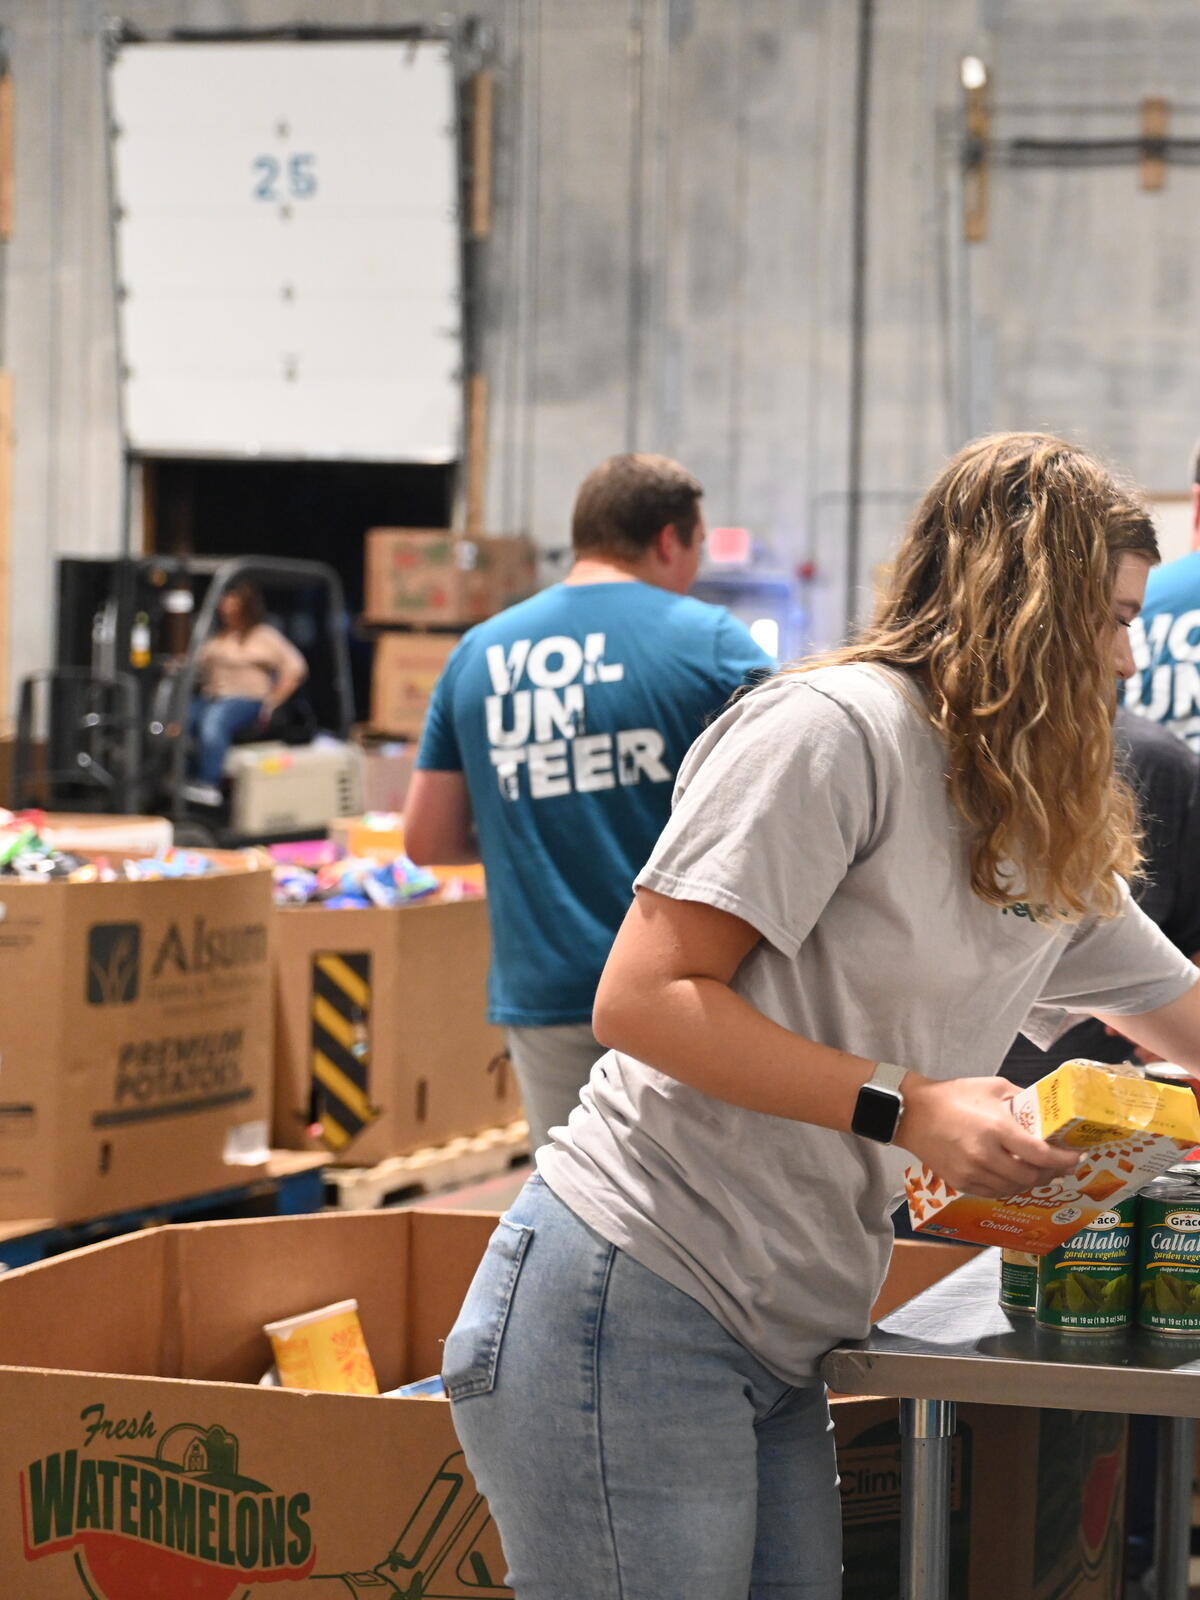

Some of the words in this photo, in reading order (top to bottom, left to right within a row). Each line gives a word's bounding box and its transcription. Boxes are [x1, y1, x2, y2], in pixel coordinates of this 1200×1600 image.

[252, 153, 318, 203] 25
[485, 632, 624, 696] VOL
[485, 685, 586, 748] UN
[489, 728, 674, 803] TEER
[980, 1219, 1023, 1234] Cheddar
[1092, 1217, 1116, 1225] ace
[1063, 1251, 1094, 1260] garden
[1095, 1249, 1128, 1261] vegetable
[1153, 1252, 1181, 1261] garden
[1061, 1315, 1070, 1323] Net
[1093, 1317, 1100, 1325] (1
[1151, 1316, 1159, 1324] Net
[1181, 1318, 1187, 1327] (1
[80, 1403, 156, 1447] Fresh
[28, 1449, 313, 1571] WATERMELONS
